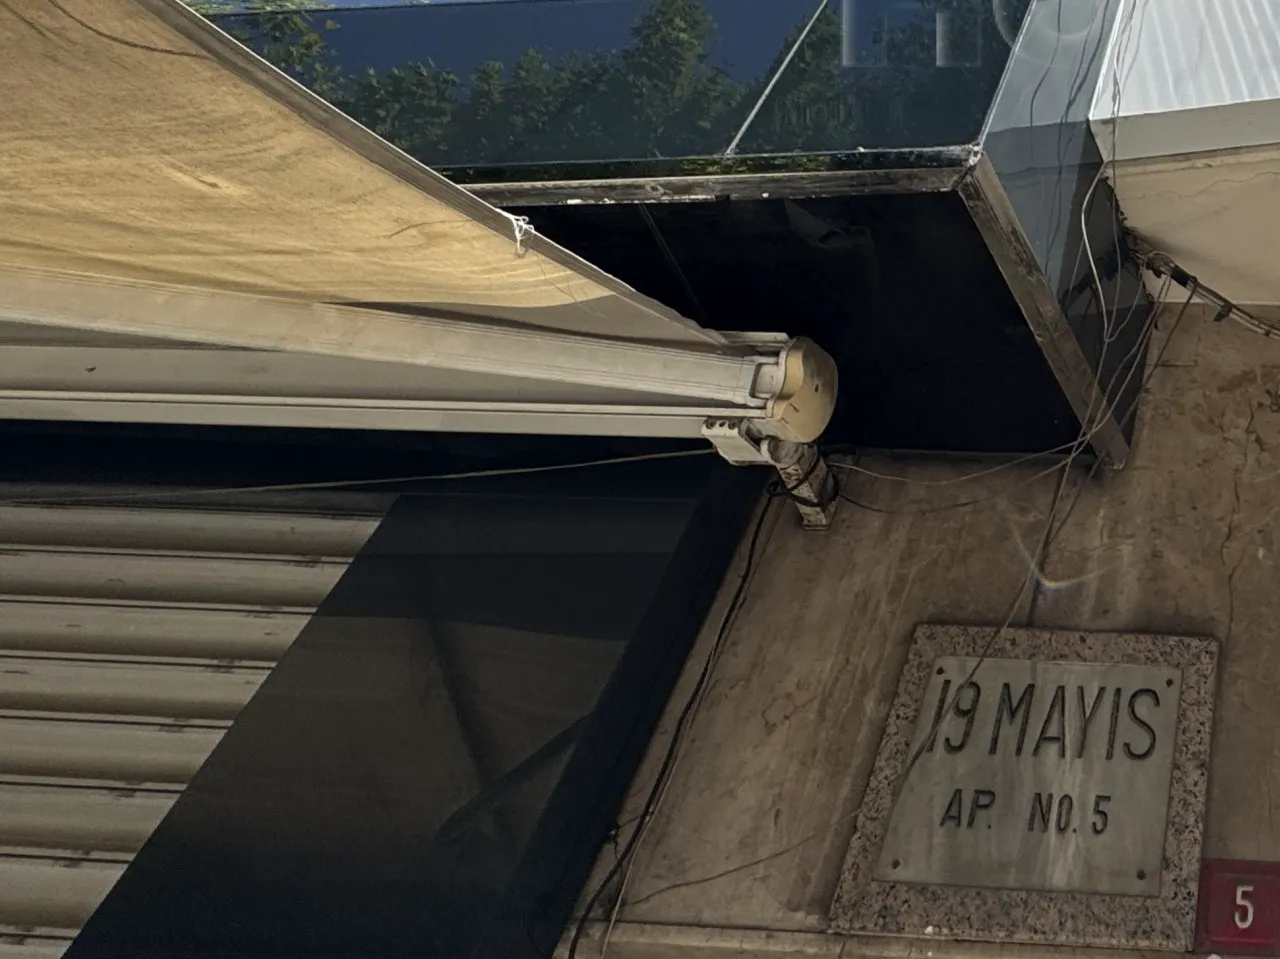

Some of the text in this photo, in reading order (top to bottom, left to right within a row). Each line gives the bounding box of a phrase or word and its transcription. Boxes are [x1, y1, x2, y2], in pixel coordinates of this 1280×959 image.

[925, 680, 1161, 761] 19 MAYIS
[939, 788, 1111, 834] AP. NO. 5
[1233, 885, 1254, 929] 5
